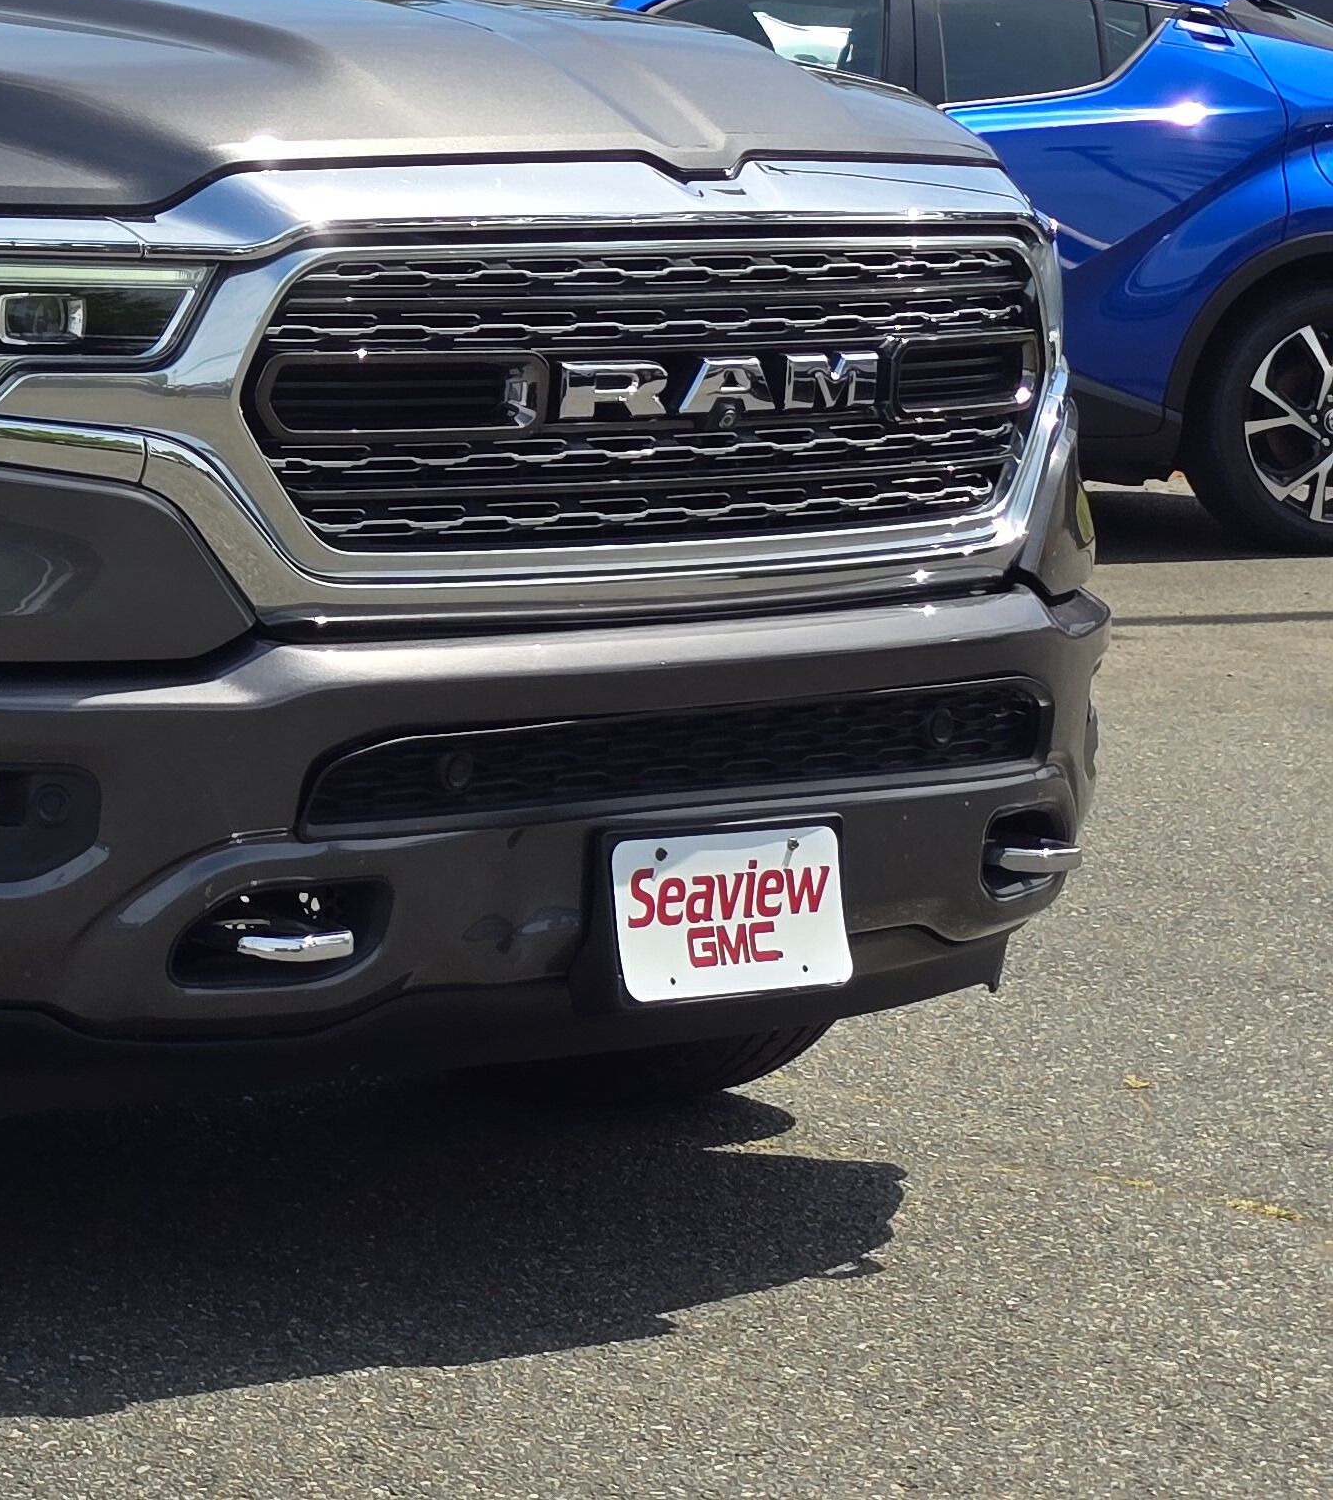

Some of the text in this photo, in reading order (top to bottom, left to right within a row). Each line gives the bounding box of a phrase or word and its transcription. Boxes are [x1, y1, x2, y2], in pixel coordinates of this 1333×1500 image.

[559, 350, 880, 419] RAM
[627, 859, 831, 929] Seaview
[686, 920, 784, 969] GMC
